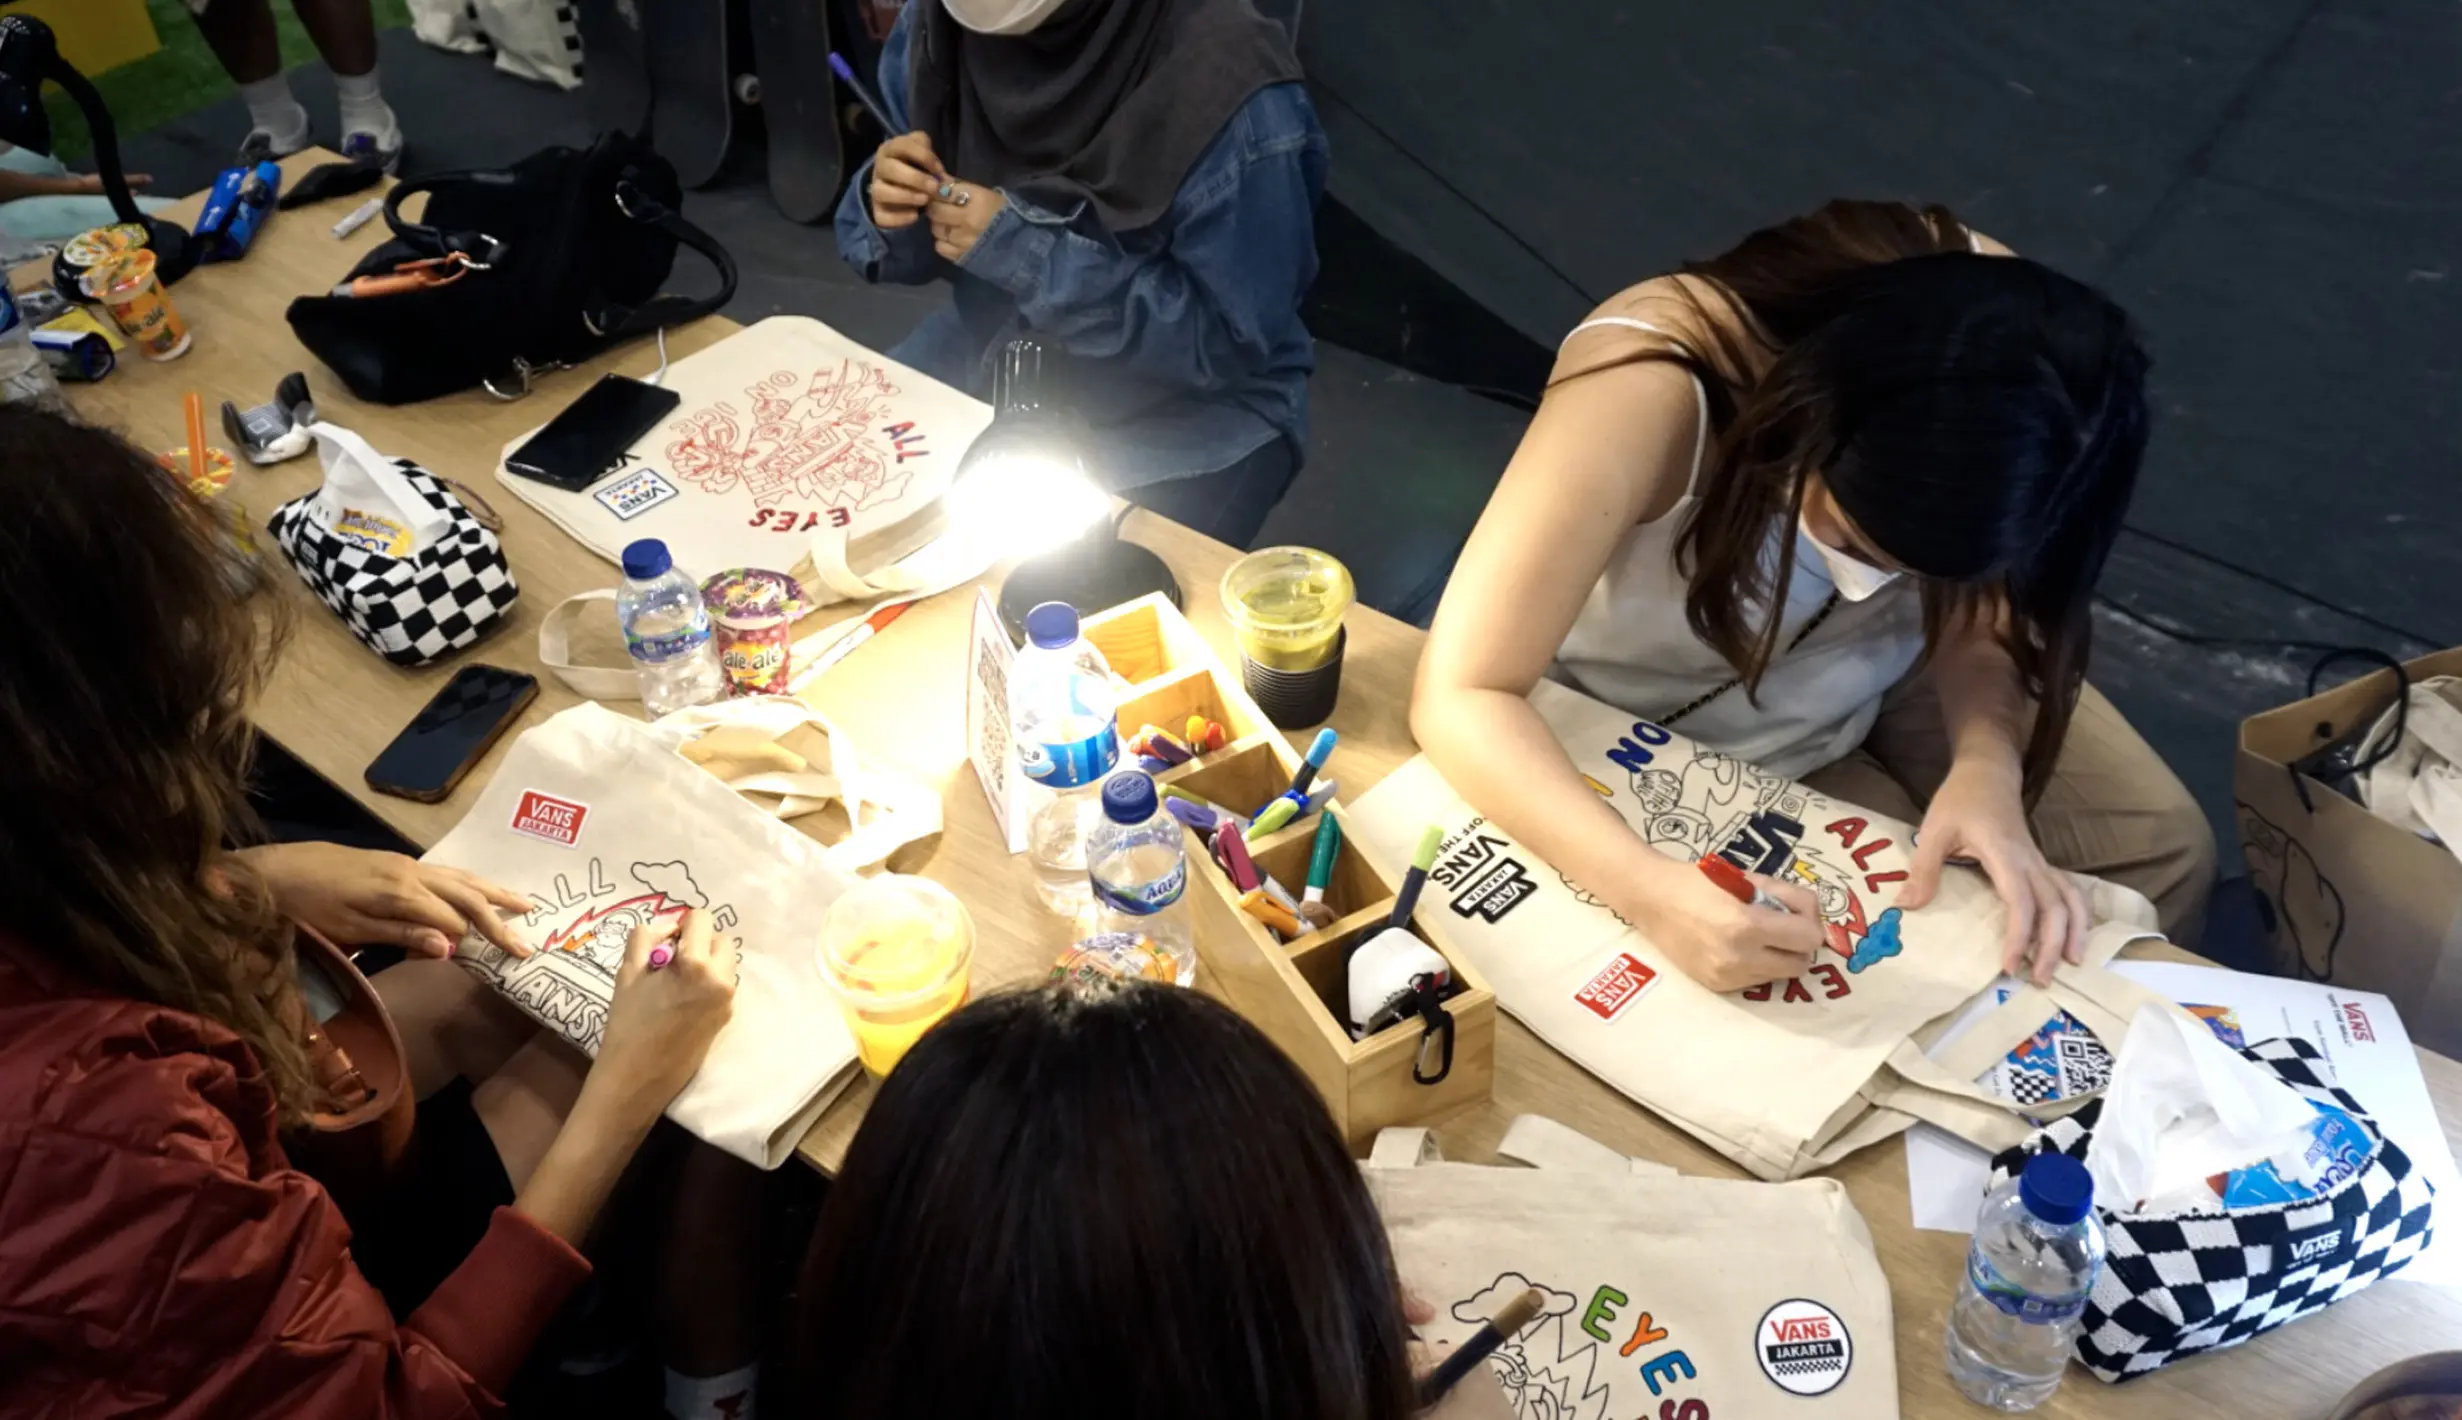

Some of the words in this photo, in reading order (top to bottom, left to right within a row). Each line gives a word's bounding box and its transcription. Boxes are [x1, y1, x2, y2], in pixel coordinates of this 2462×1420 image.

[881, 420, 931, 463] ALL
[619, 486, 667, 513] VANS
[748, 507, 851, 532] EYES
[1606, 721, 1672, 773] ON
[532, 797, 577, 828] VANS
[1431, 834, 1510, 893] VANS
[1824, 816, 1909, 893] ALL
[523, 857, 616, 927] ALL
[1466, 870, 1509, 903] JAKARTA
[1483, 880, 1528, 915] VANS
[1580, 959, 1626, 1000] JAKARTA
[1596, 969, 1647, 1011] VANS
[2342, 1002, 2376, 1043] VANS
[2290, 1230, 2342, 1260] VANS
[1770, 1316, 1831, 1342] VANS
[1776, 1343, 1836, 1360] JAKARTA
